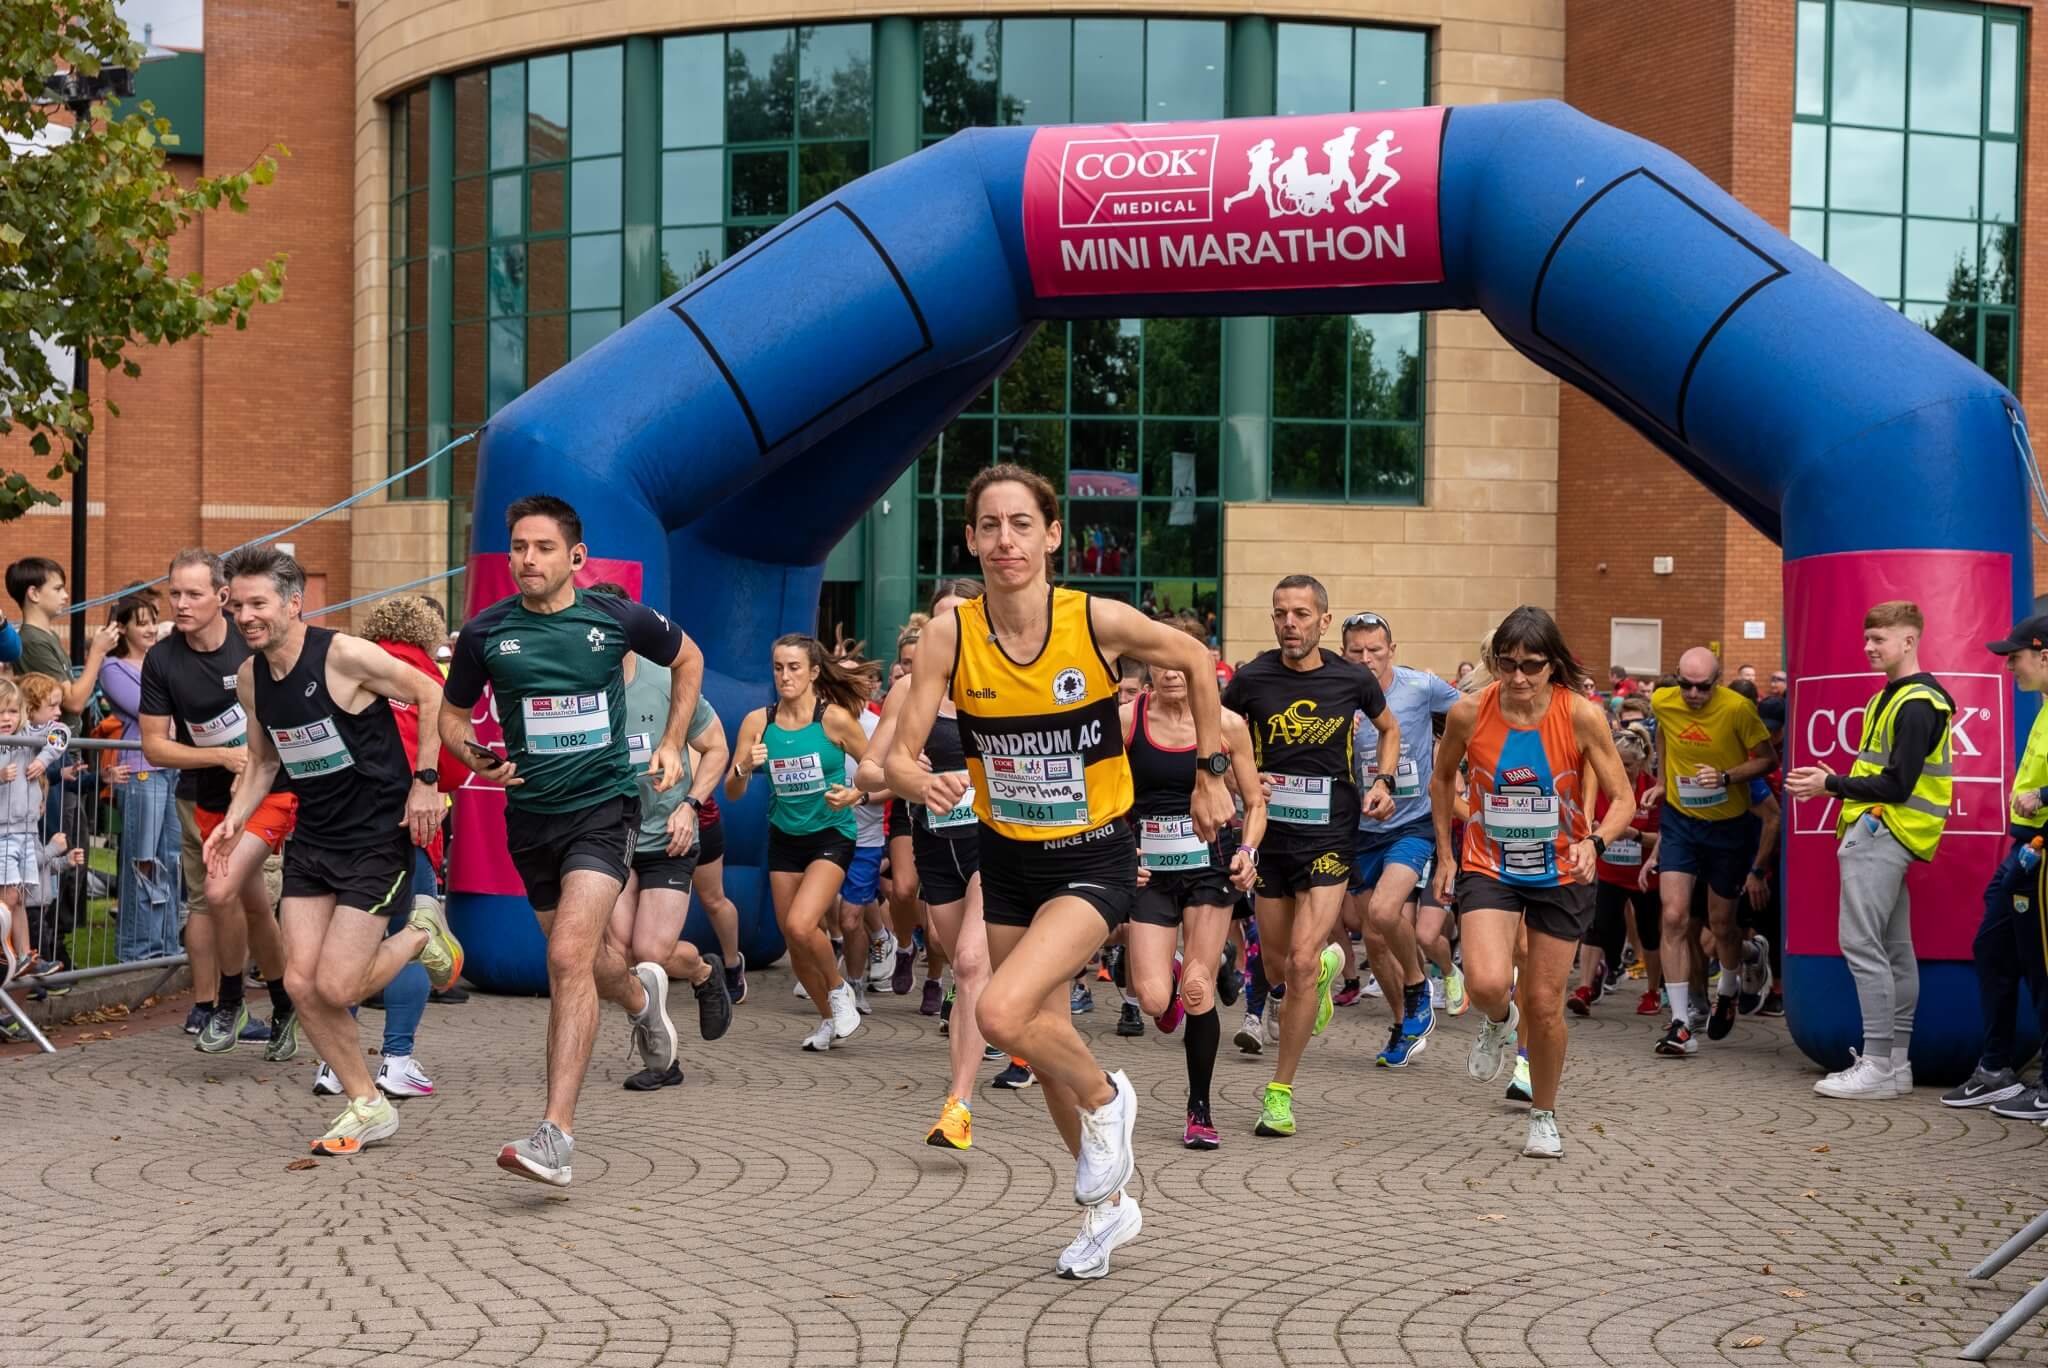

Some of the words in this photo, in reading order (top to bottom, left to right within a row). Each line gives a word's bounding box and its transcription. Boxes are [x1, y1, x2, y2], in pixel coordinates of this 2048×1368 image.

[1075, 148, 1198, 181] COOK
[1113, 199, 1197, 215] MEDICAL
[1060, 236, 1150, 272] MINI
[1161, 224, 1407, 268] MARATHON
[553, 733, 587, 748] 1082
[1078, 720, 1102, 750] AC
[302, 759, 329, 772] 2093
[778, 771, 816, 783] CAROL
[1505, 768, 1536, 782] BARR
[993, 781, 1073, 798] Dymphna
[1018, 803, 1054, 819] 1661
[1283, 808, 1309, 819] 1903
[1044, 834, 1083, 850] NIKE
[1085, 823, 1115, 842] PRO
[1506, 828, 1535, 838] 2081
[1160, 854, 1188, 866] 2092
